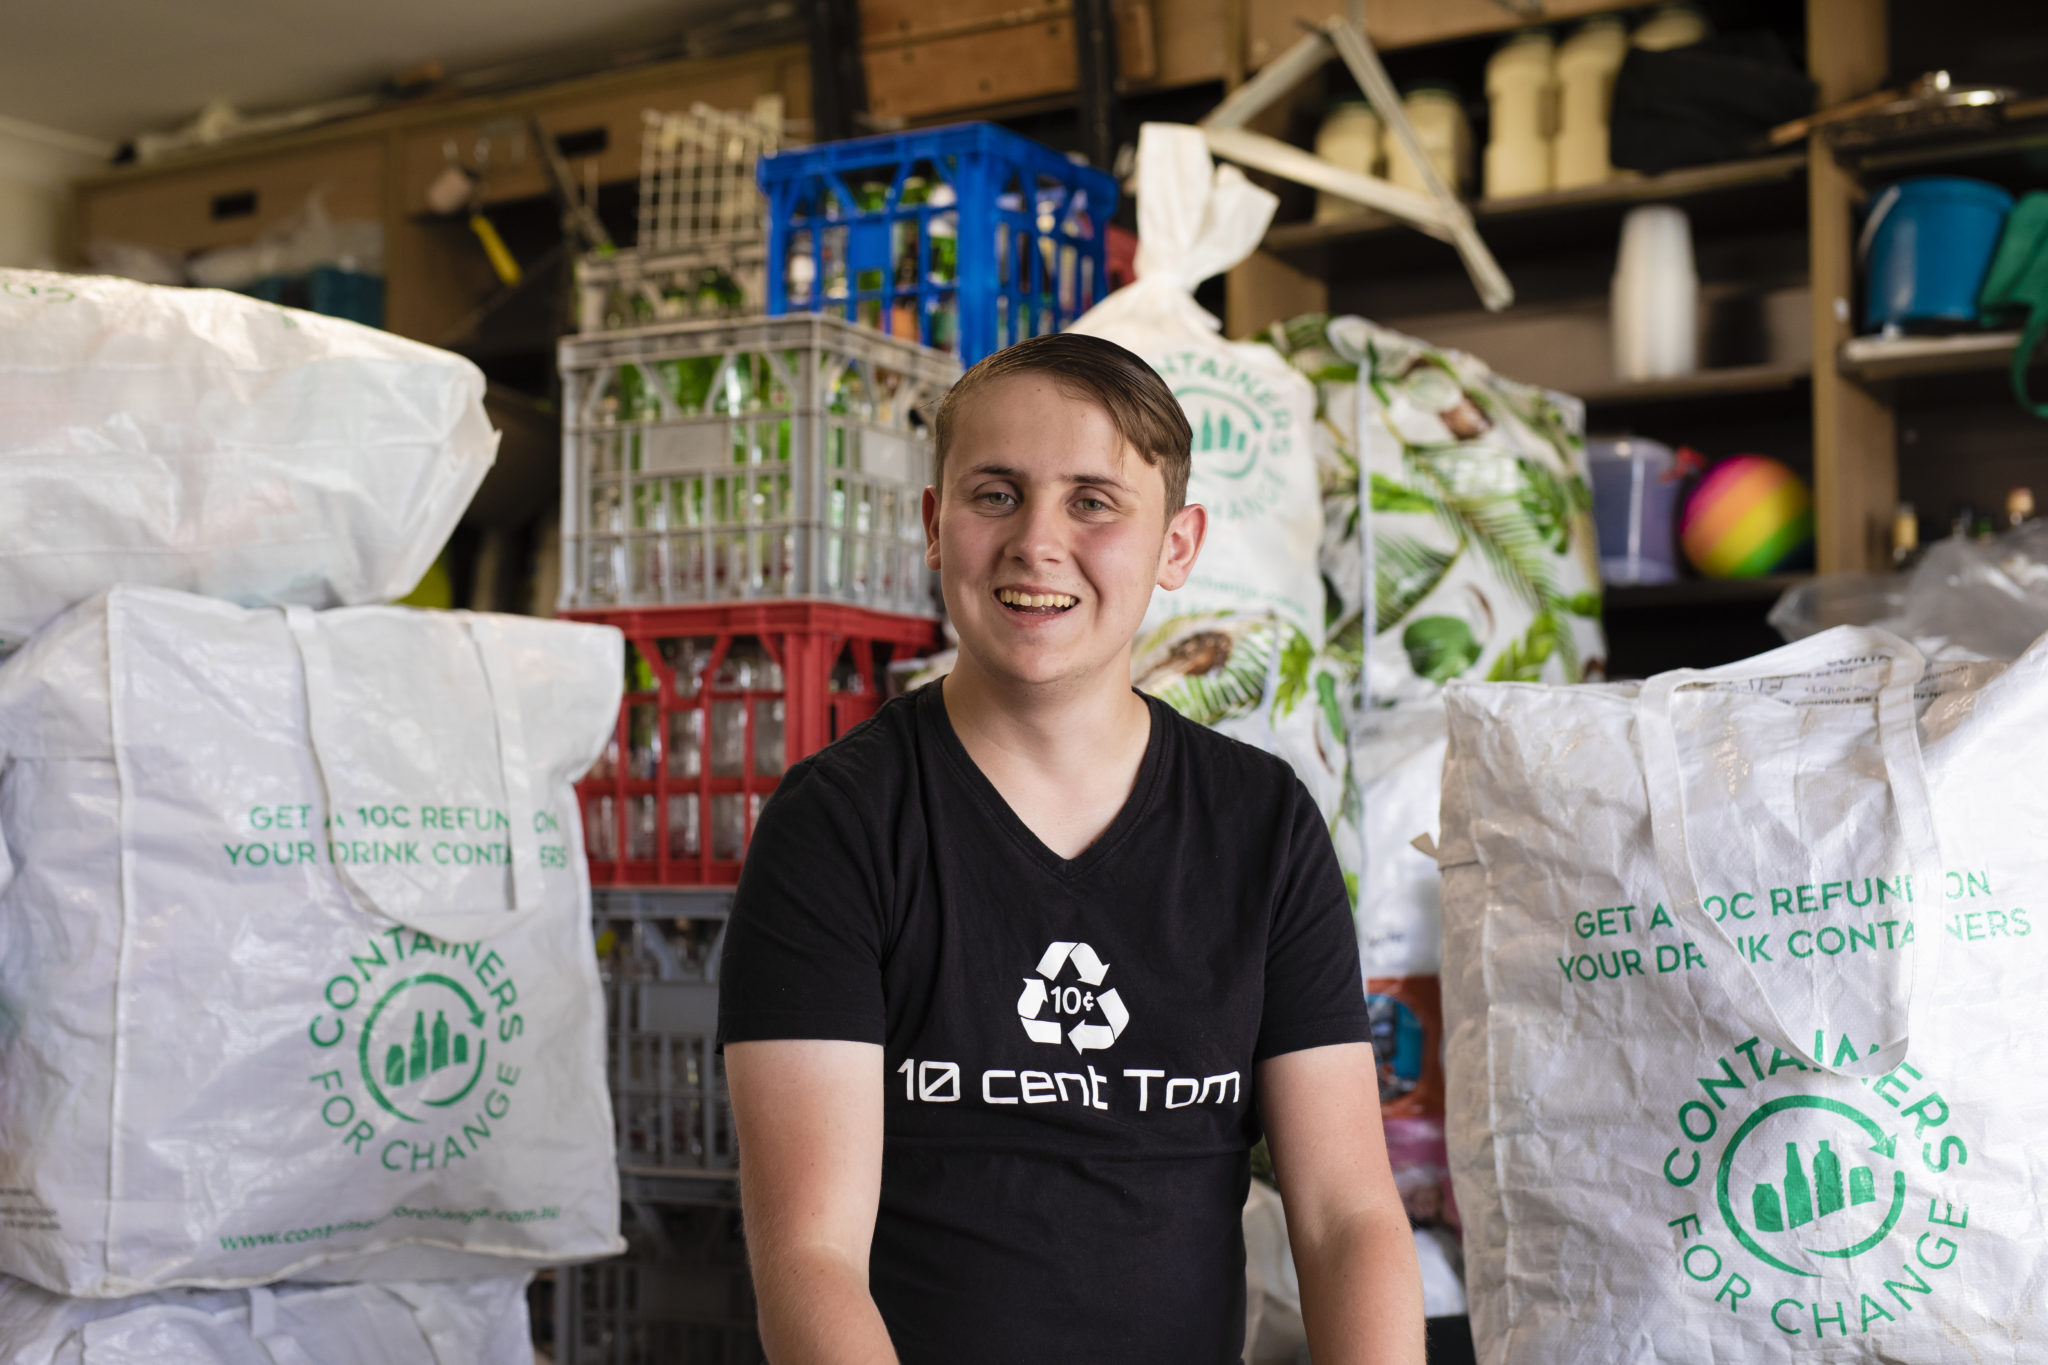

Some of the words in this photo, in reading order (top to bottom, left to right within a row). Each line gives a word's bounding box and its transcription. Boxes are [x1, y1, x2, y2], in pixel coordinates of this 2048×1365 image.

[249, 804, 313, 831] GET
[420, 805, 511, 832] REFUN
[223, 840, 316, 867] YOUR
[327, 840, 422, 866] DRINK
[431, 841, 568, 870] CONTERS
[1574, 904, 1637, 940] GET
[1648, 901, 1675, 931] A
[1945, 870, 1993, 900] ON
[1556, 947, 1645, 983] YOUR
[1656, 932, 1774, 975] DRK
[1786, 906, 2033, 959] CONTANERS
[309, 1069, 375, 1156] FOR
[380, 1060, 522, 1173] CHANGE
[897, 1058, 961, 1102] 10
[982, 1065, 1109, 1111] cent
[1123, 1068, 1241, 1112] Tom
[1667, 1212, 1753, 1314] FOR
[1770, 1198, 1971, 1339] CHANGE
